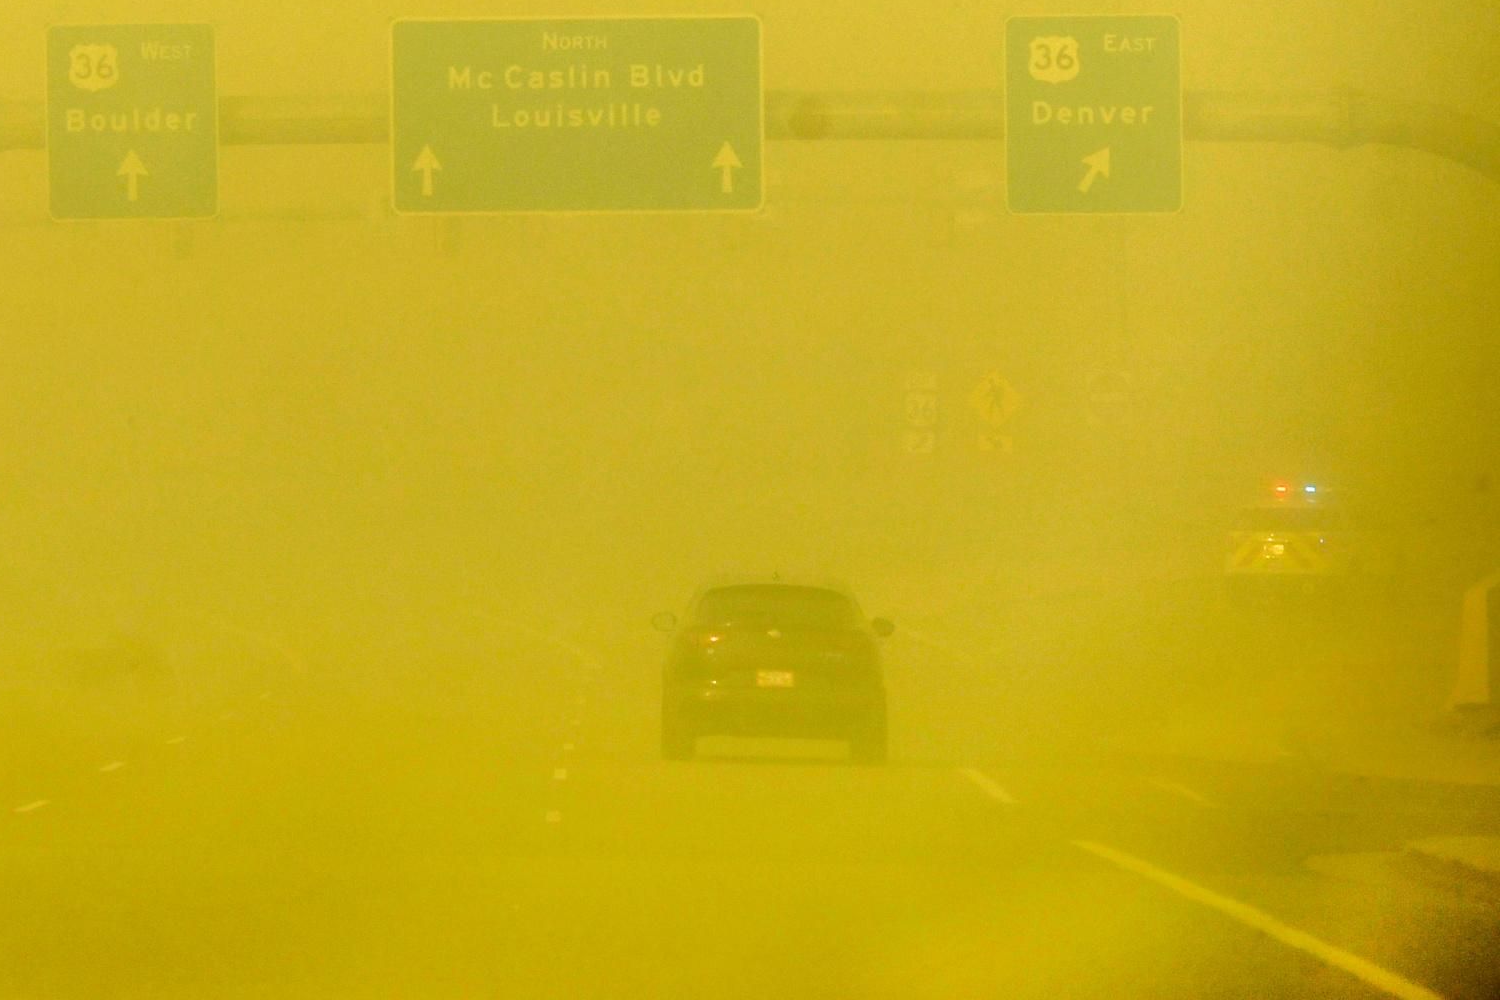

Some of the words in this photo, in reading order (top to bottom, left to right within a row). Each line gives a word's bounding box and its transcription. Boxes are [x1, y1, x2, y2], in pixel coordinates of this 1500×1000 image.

[1103, 34, 1156, 52] EAST
[75, 53, 114, 80] 36
[1034, 43, 1075, 70] 36
[628, 63, 705, 88] Blvd
[65, 107, 198, 133] Boulder
[491, 103, 663, 128] Louisville
[1032, 100, 1155, 125] Denver
